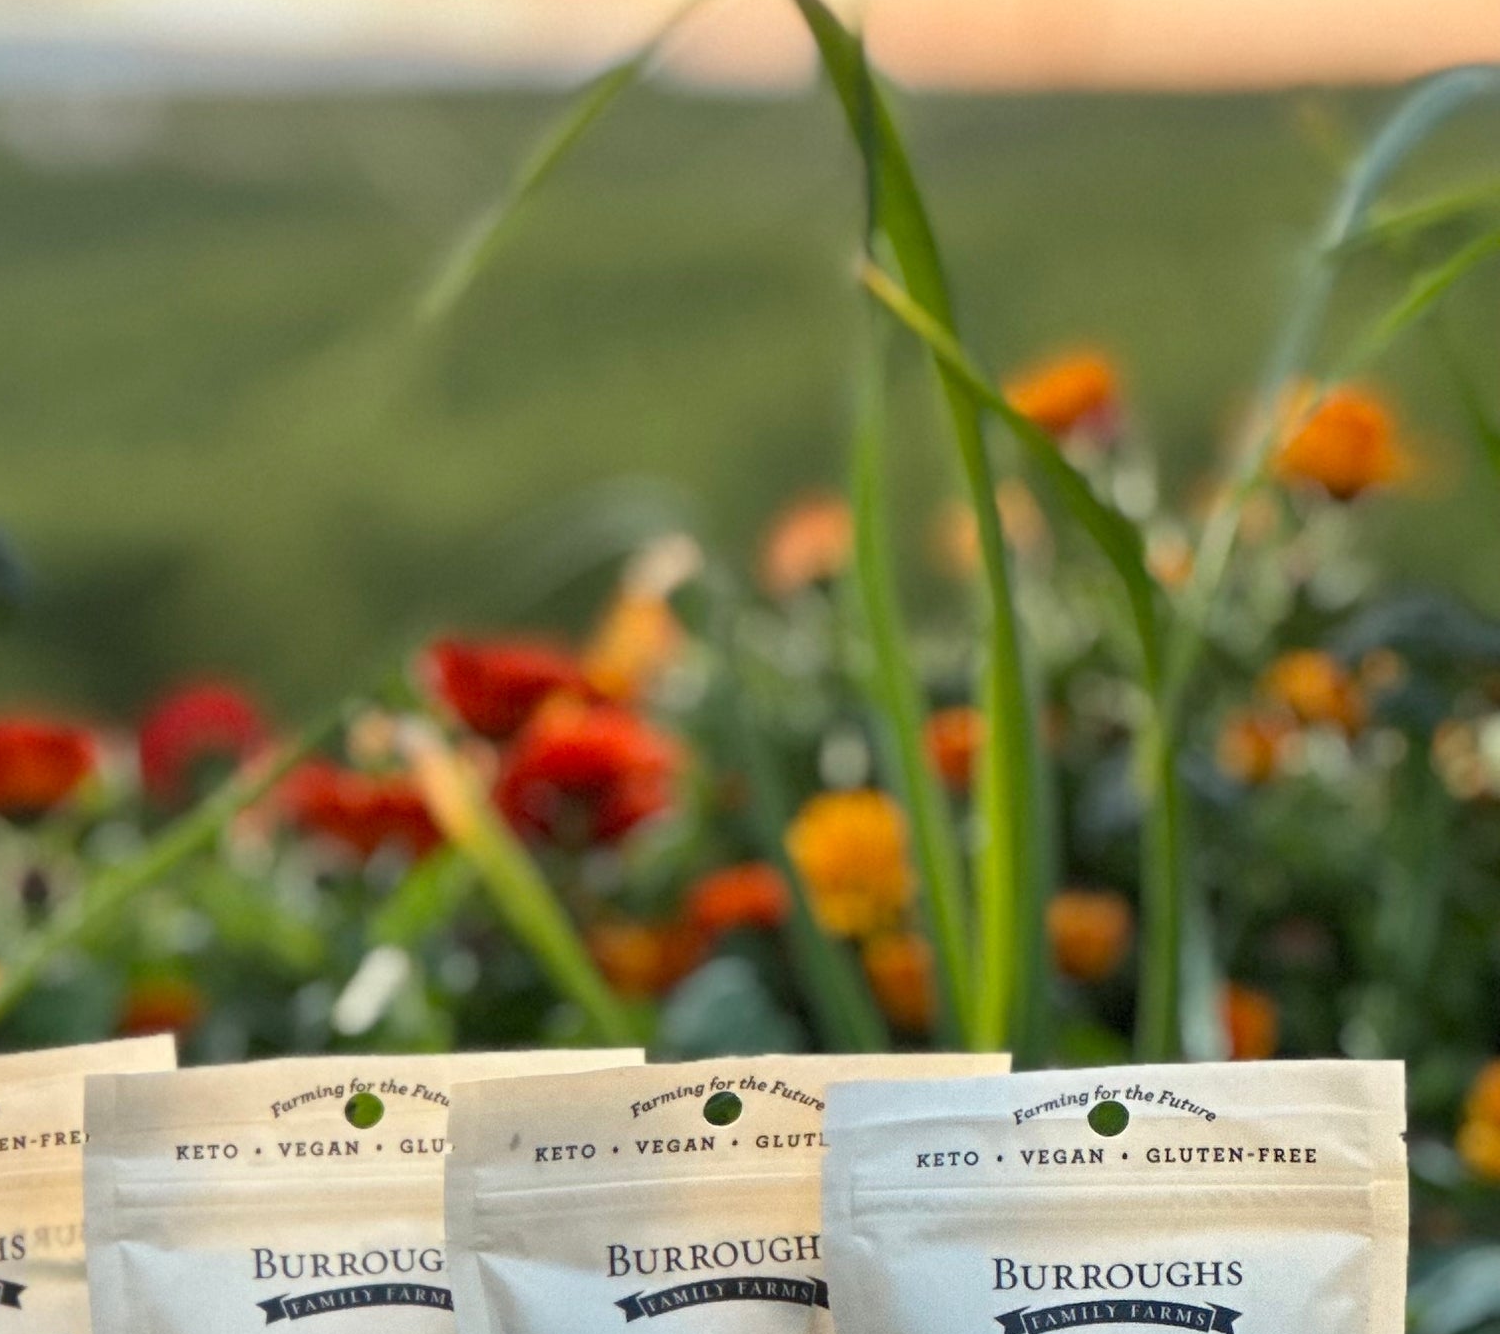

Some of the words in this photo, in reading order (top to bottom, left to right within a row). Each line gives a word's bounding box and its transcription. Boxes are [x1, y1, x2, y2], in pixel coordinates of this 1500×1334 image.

[270, 1083, 344, 1119] Farming
[349, 1077, 375, 1094] for
[380, 1078, 408, 1095] the
[630, 1082, 704, 1119] Farming
[709, 1075, 735, 1092] for
[739, 1075, 767, 1092] the
[770, 1080, 825, 1111] Future
[1013, 1089, 1090, 1126] Farming
[1093, 1084, 1121, 1101] for
[1125, 1084, 1154, 1103] the
[1157, 1089, 1216, 1123] Future
[176, 1144, 239, 1160] KETO
[278, 1140, 360, 1158] VEGAN
[535, 1145, 596, 1162] KETO
[636, 1136, 715, 1155] VEGAN
[916, 1150, 979, 1168] KETO
[1020, 1149, 1104, 1165] VEGAN
[1146, 1147, 1317, 1164] GLUTEN-FREE
[251, 1248, 445, 1281] BURROUG
[606, 1235, 821, 1278] BURROUGH
[992, 1257, 1243, 1291] BURROUGHS
[290, 1289, 373, 1317] FAMILY
[648, 1284, 725, 1312] FAMILY
[738, 1281, 811, 1300] FARMS
[1030, 1303, 1118, 1331] FAMILY
[1130, 1303, 1205, 1327] FARMS
